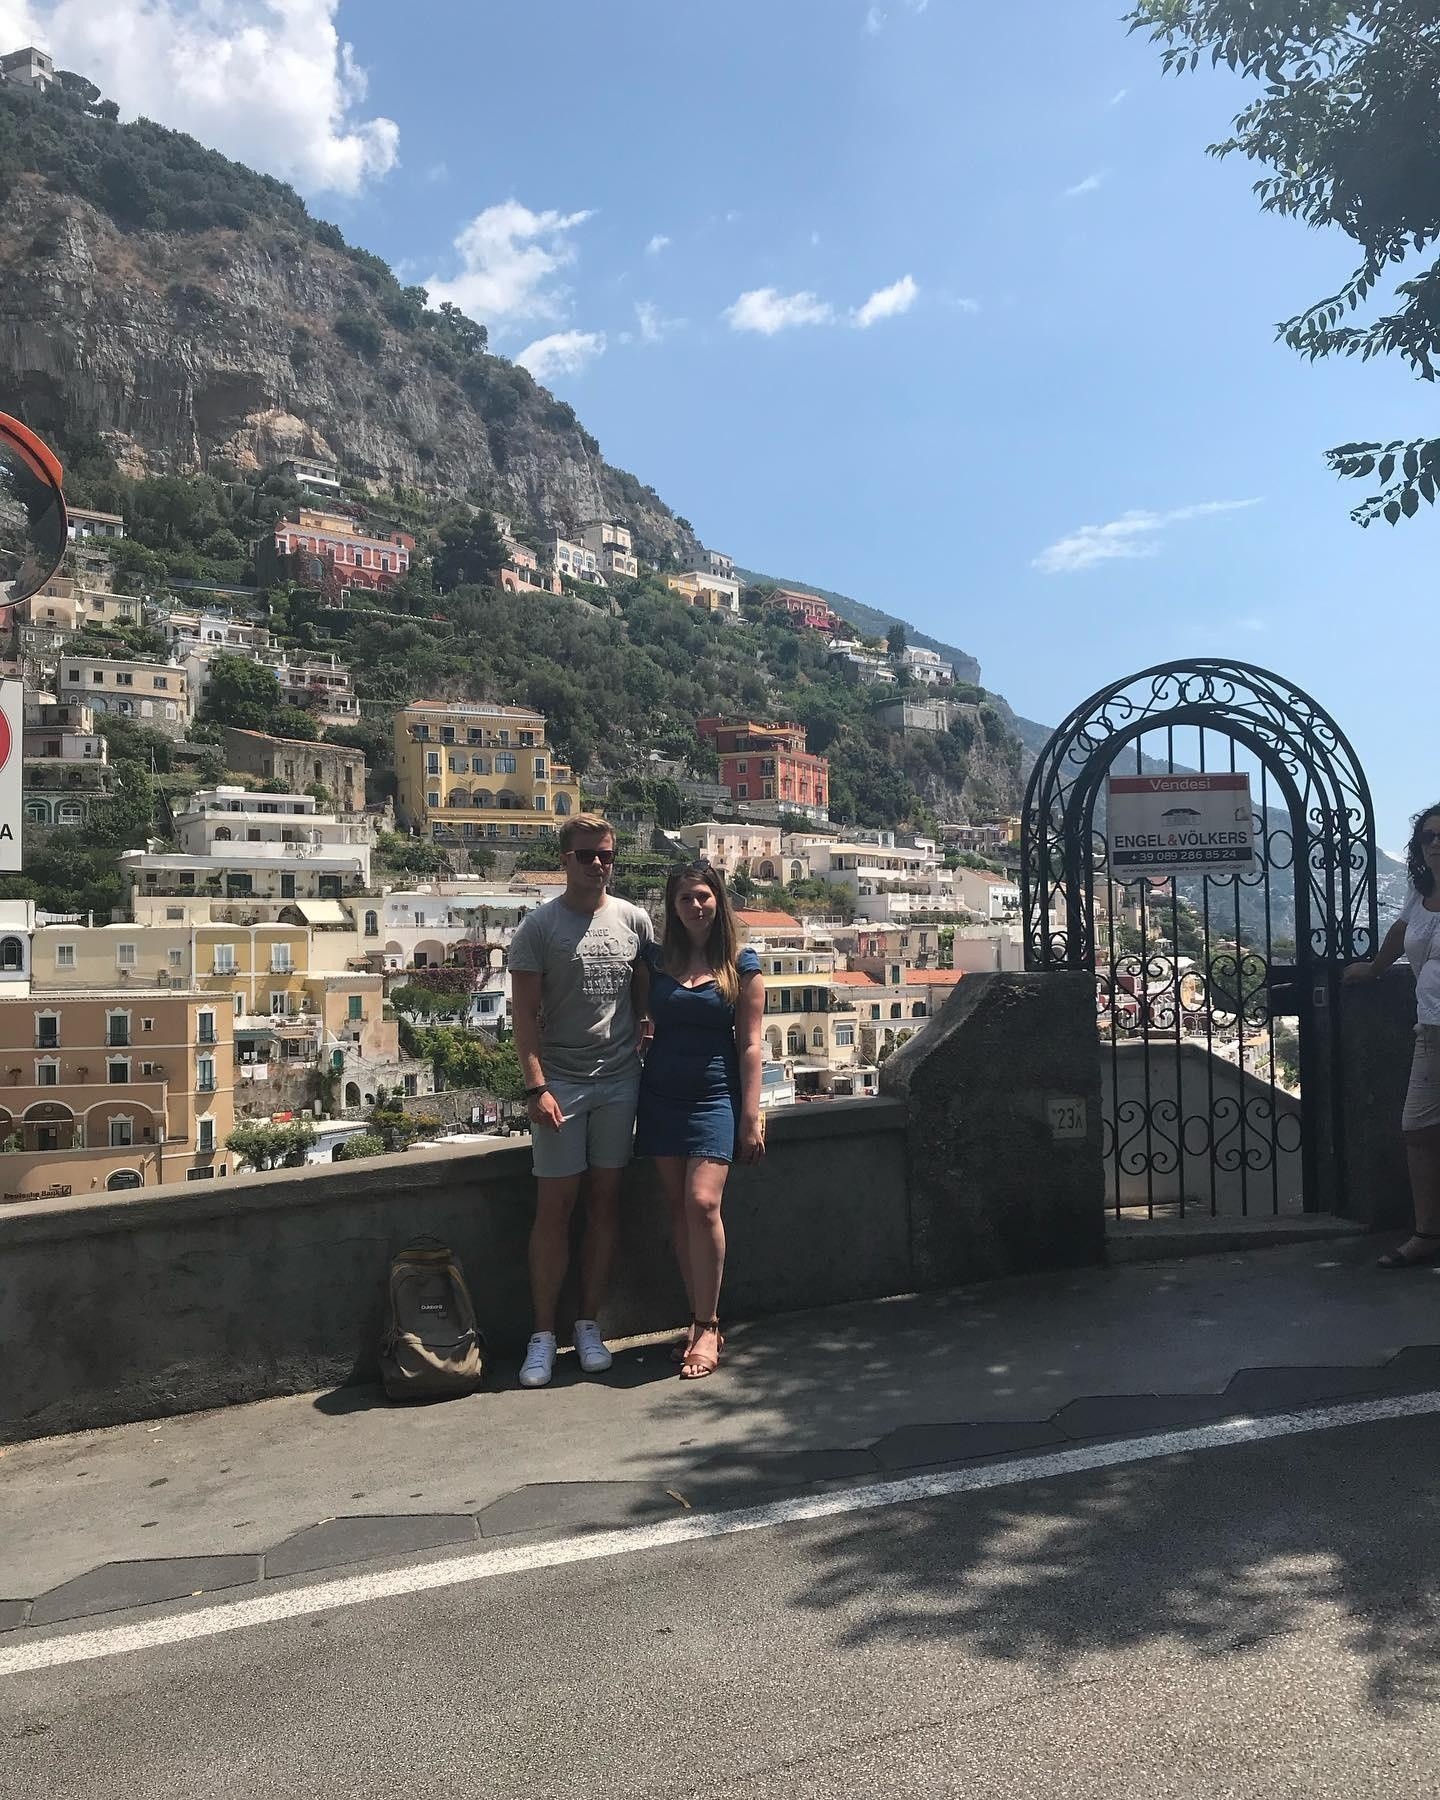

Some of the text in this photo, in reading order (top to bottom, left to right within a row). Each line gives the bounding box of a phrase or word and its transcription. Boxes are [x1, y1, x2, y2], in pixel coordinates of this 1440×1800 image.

[1149, 778, 1211, 791] Vendesi
[1114, 830, 1248, 848] ENGEL&VÖLKERS
[1156, 852, 1178, 861] 089
[1181, 850, 1203, 860] 286
[1222, 849, 1237, 858] 24
